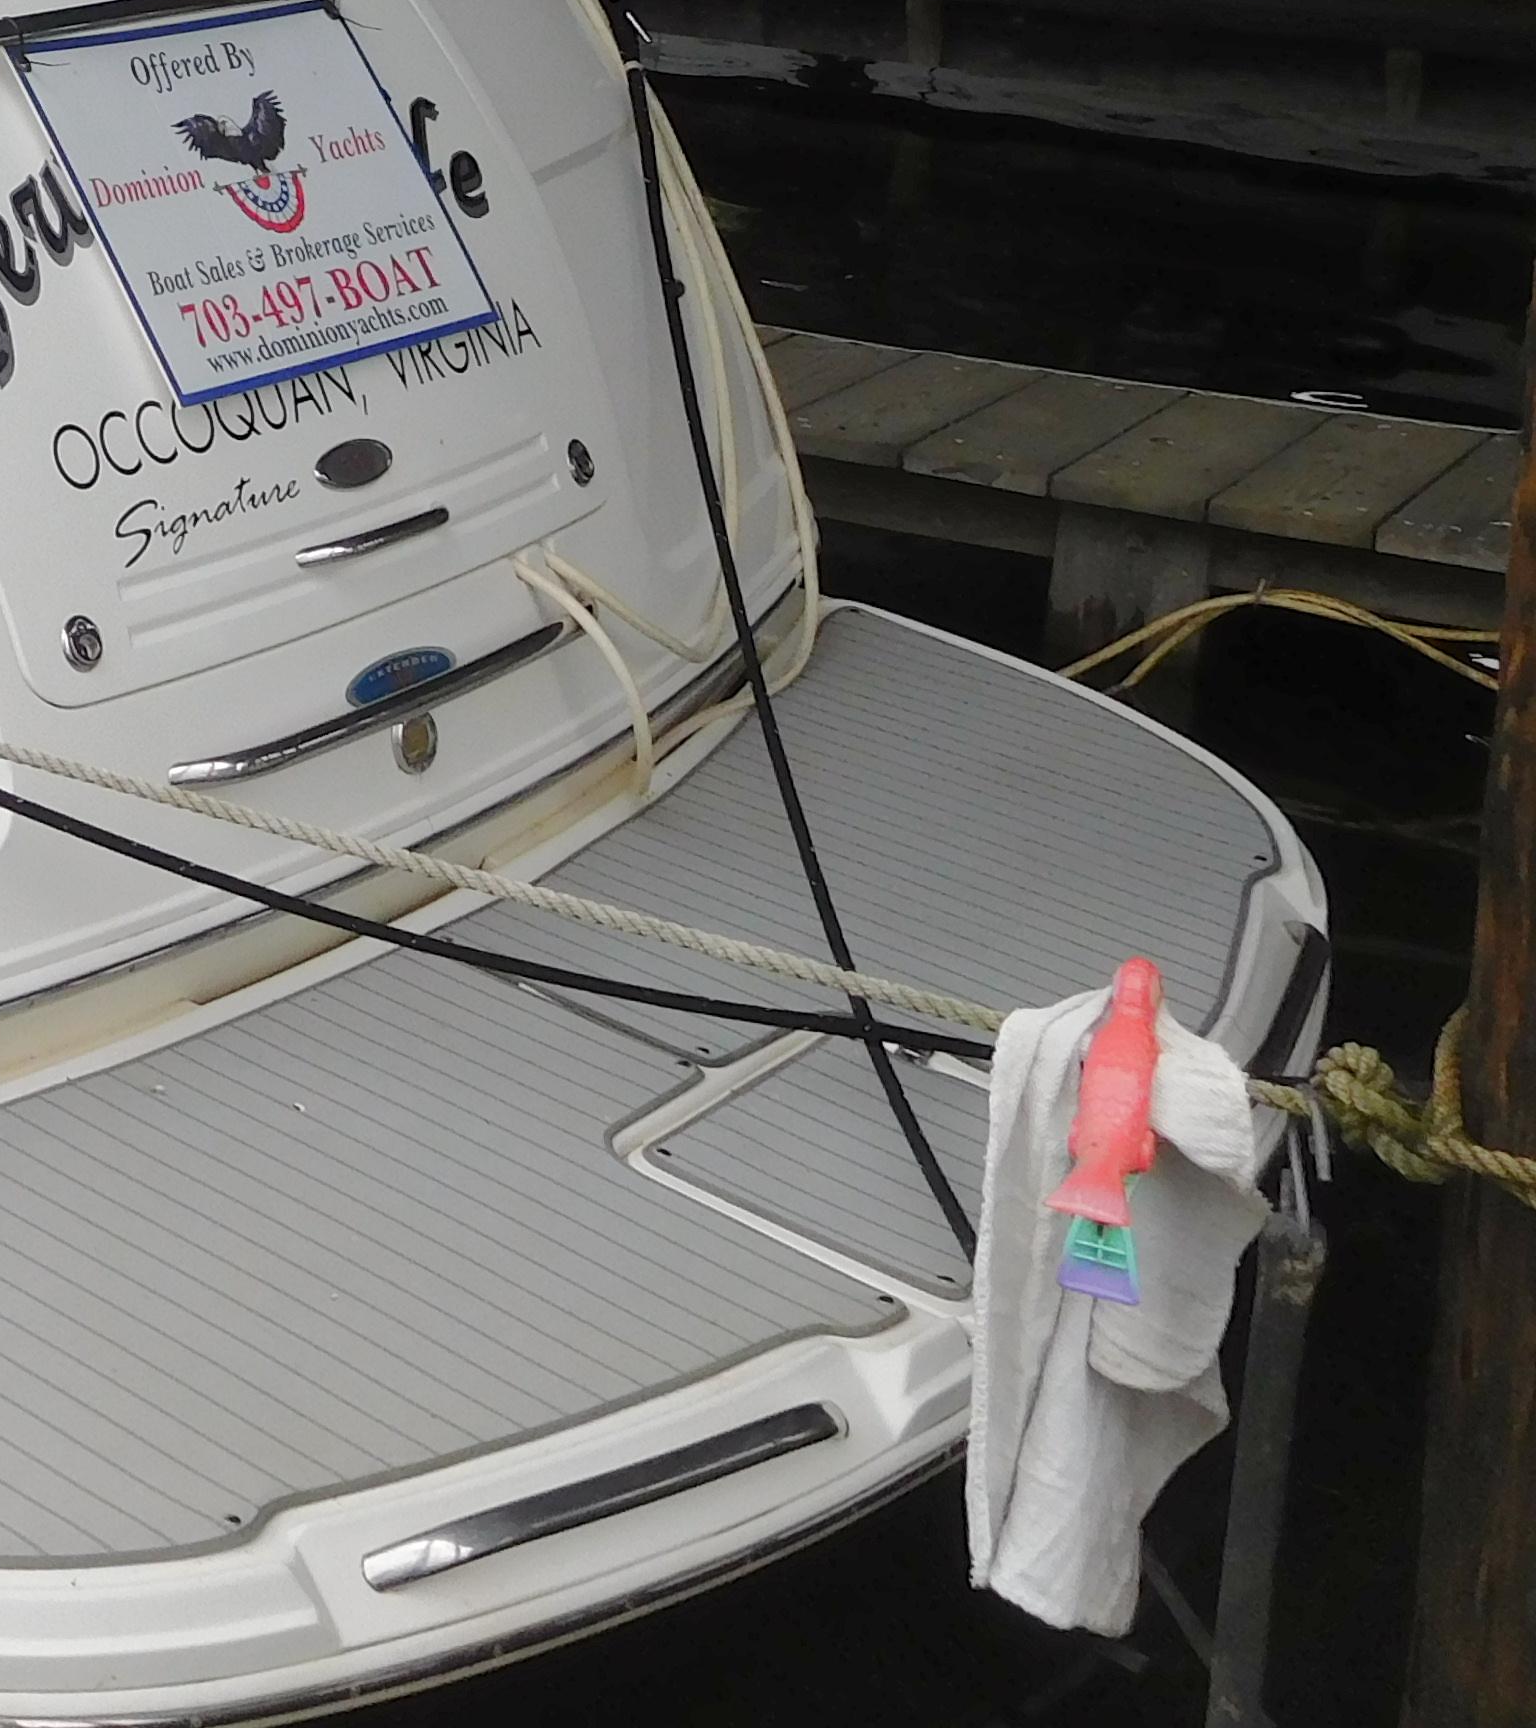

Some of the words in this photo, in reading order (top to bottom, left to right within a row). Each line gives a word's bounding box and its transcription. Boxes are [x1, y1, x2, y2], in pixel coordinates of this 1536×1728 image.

[130, 44, 221, 93] Offered
[221, 41, 258, 77] By
[89, 167, 206, 208] Dominion
[308, 126, 387, 164] Yachts
[147, 268, 195, 298] Boat
[194, 255, 246, 286] Sales
[247, 247, 266, 272] &
[269, 230, 362, 270] Brokerage
[363, 213, 436, 247] Services
[178, 246, 443, 349] 703-497-BOAT
[206, 294, 450, 374] www.dominionyachts.com
[383, 298, 543, 392] VIRGINIA
[115, 476, 301, 568] Signature
